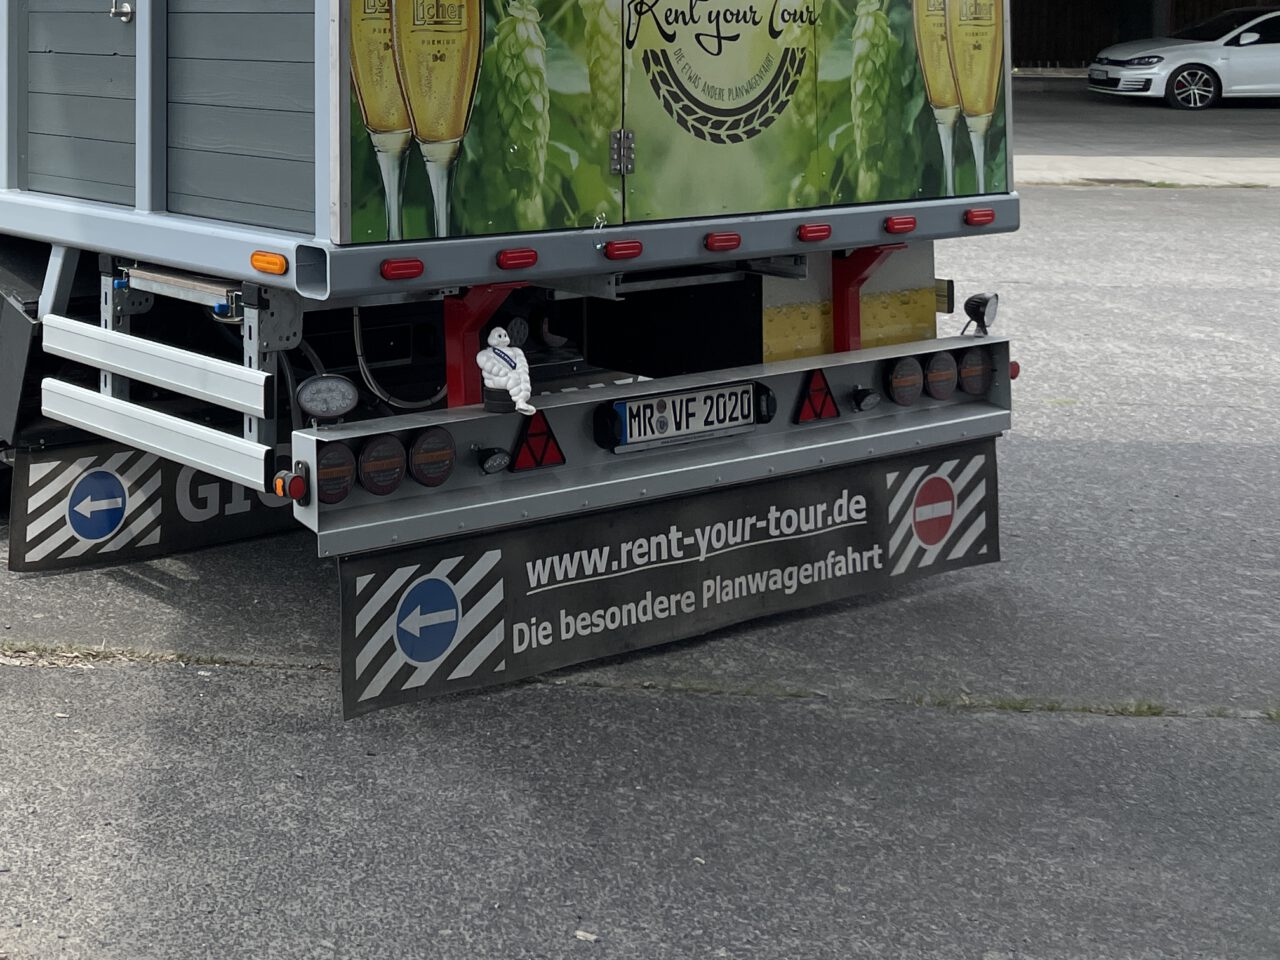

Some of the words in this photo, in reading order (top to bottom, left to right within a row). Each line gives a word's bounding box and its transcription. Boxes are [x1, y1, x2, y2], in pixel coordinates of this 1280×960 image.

[694, 5, 764, 57] your
[673, 47, 686, 66] DIE
[681, 62, 702, 90] ETWAS
[701, 84, 726, 102] ANDERE
[628, 403, 655, 438] MR
[671, 397, 697, 431] VF
[703, 390, 751, 427] 2020
[525, 489, 867, 588] www.rent-your-tour.de
[512, 618, 553, 654] Die
[559, 591, 695, 641] besondere
[702, 544, 883, 609] Planwagenfahrt
